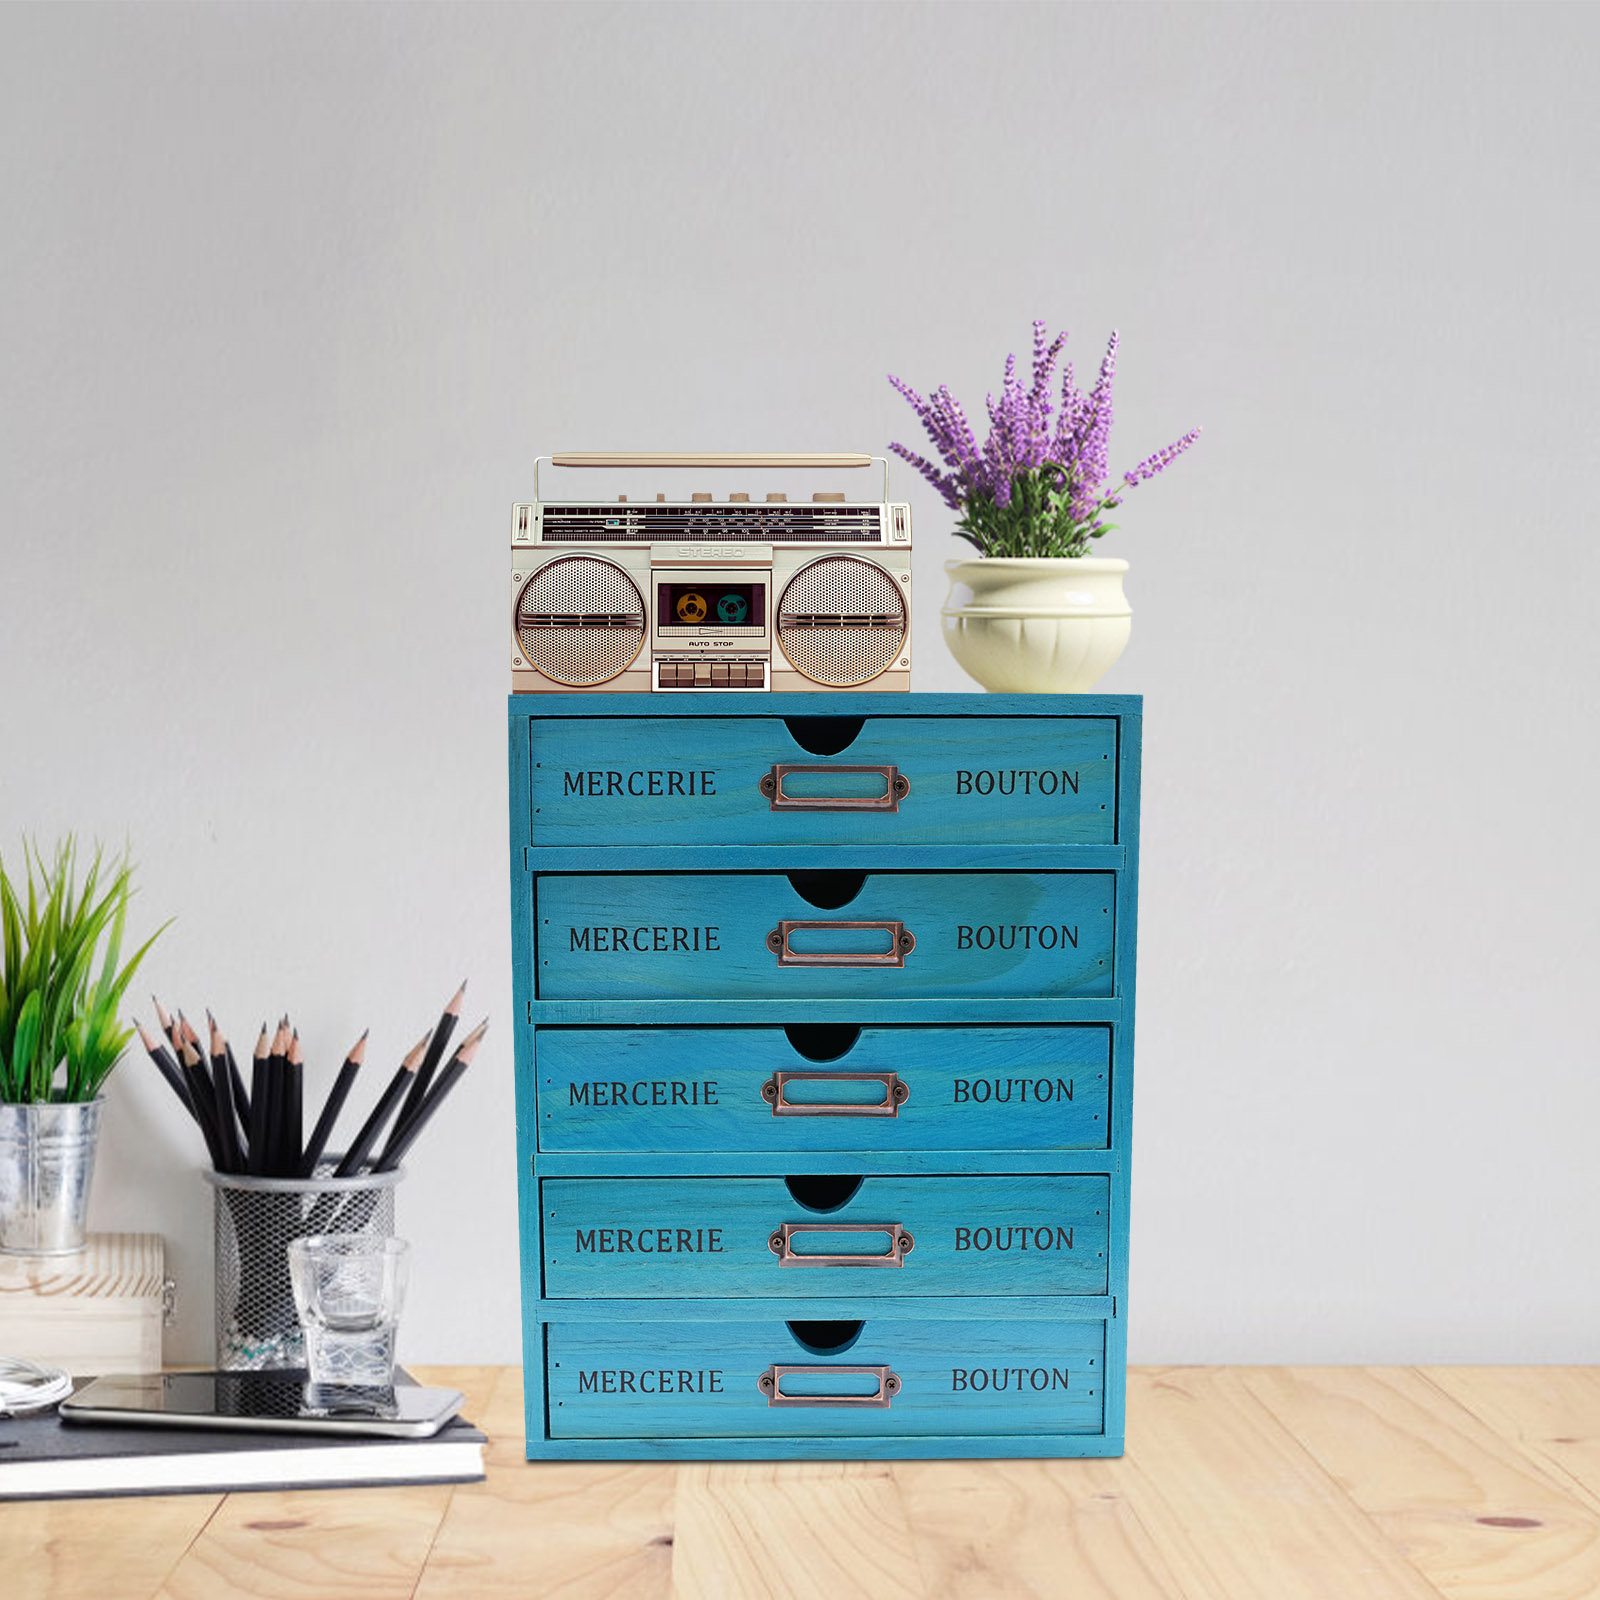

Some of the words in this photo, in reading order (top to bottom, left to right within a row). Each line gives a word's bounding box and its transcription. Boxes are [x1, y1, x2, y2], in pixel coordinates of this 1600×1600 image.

[679, 547, 744, 558] STEREO
[564, 771, 716, 796] MERCERIE
[957, 771, 1078, 795] BOUTON
[571, 927, 720, 951] MERCERIE
[958, 925, 1077, 949] BOUTON
[570, 1082, 718, 1105] MERCERIE
[954, 1079, 1073, 1102] BOUTON
[576, 1229, 723, 1252] MERCERIE
[956, 1227, 1072, 1250] BOUTON
[580, 1371, 723, 1392] MERCERIE
[953, 1369, 1067, 1390] BOUTON
